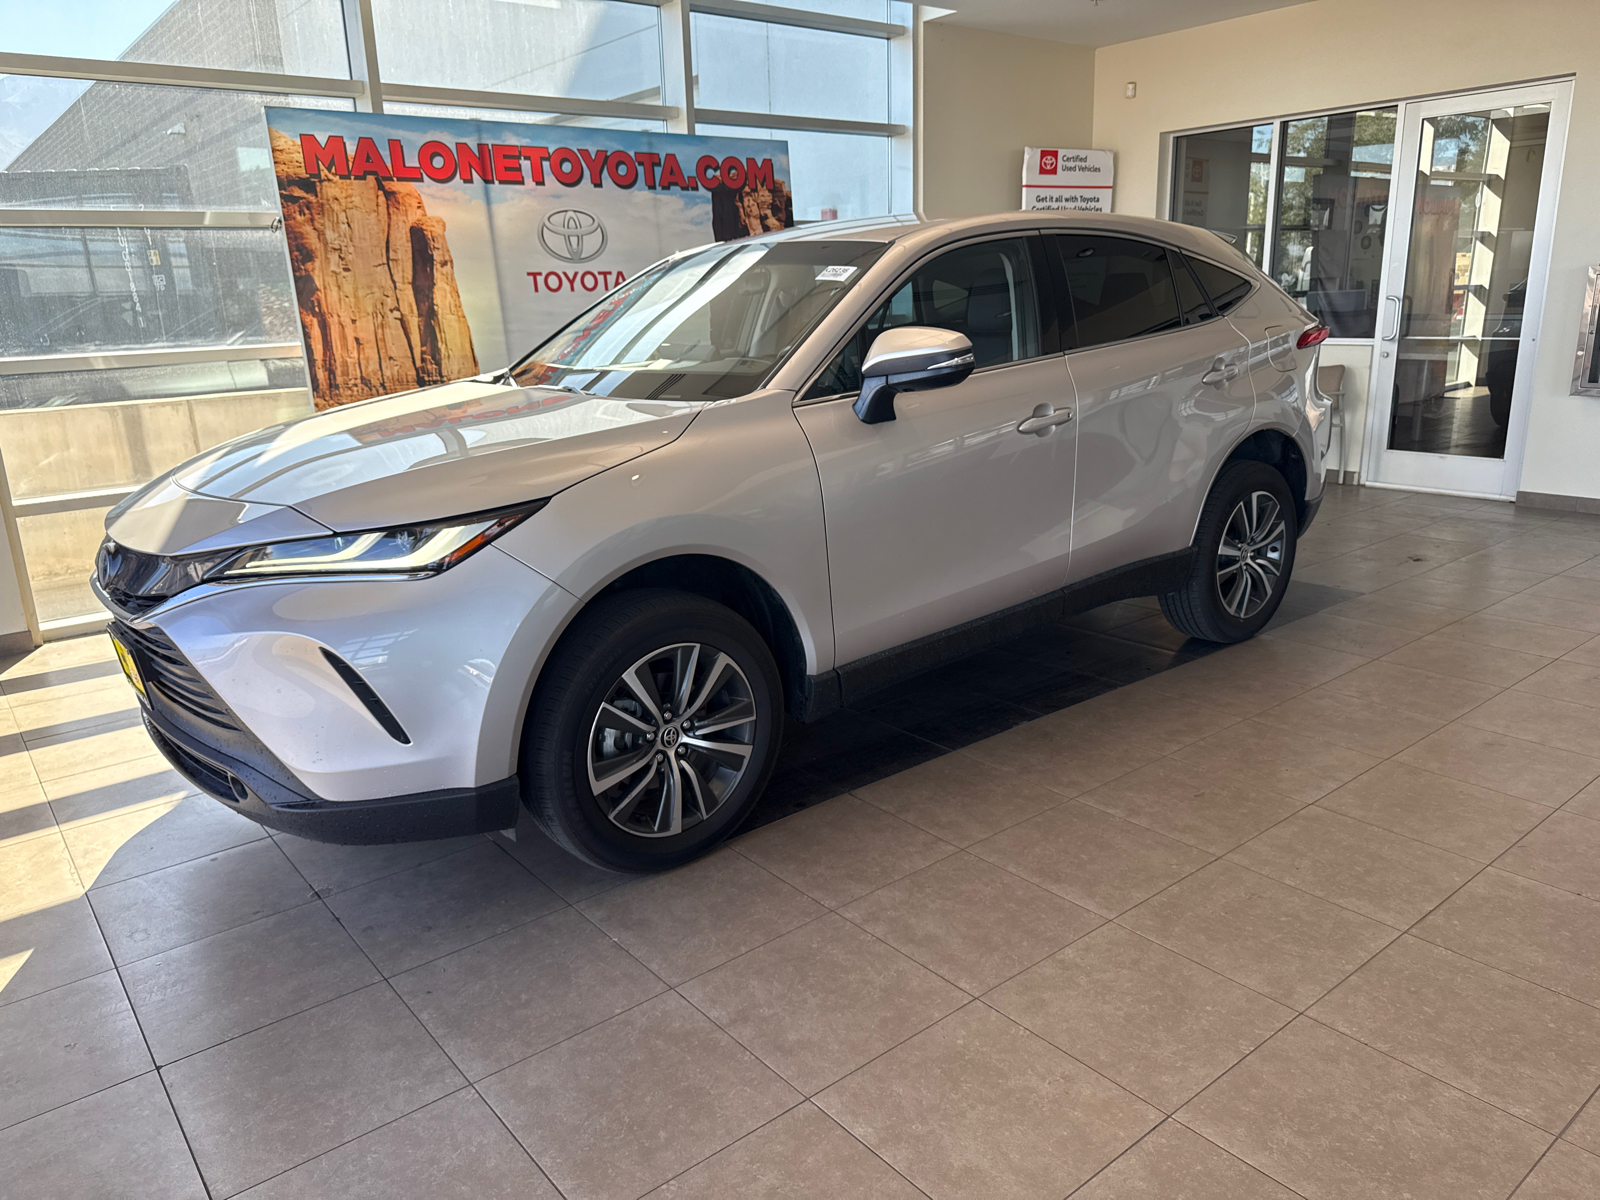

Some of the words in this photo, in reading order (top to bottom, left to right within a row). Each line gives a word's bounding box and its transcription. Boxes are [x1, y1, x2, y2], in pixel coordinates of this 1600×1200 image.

[299, 133, 775, 191] MALONETOYOTA.COM
[1061, 154, 1088, 163] Certified
[1061, 164, 1077, 172] Used
[1078, 164, 1101, 173] Vehicles
[1035, 195, 1048, 203] Get
[1048, 195, 1054, 203] it
[1054, 195, 1063, 203] all
[1064, 195, 1079, 203] with
[1079, 195, 1100, 205] Toyota
[526, 270, 628, 293] TOYOTA
